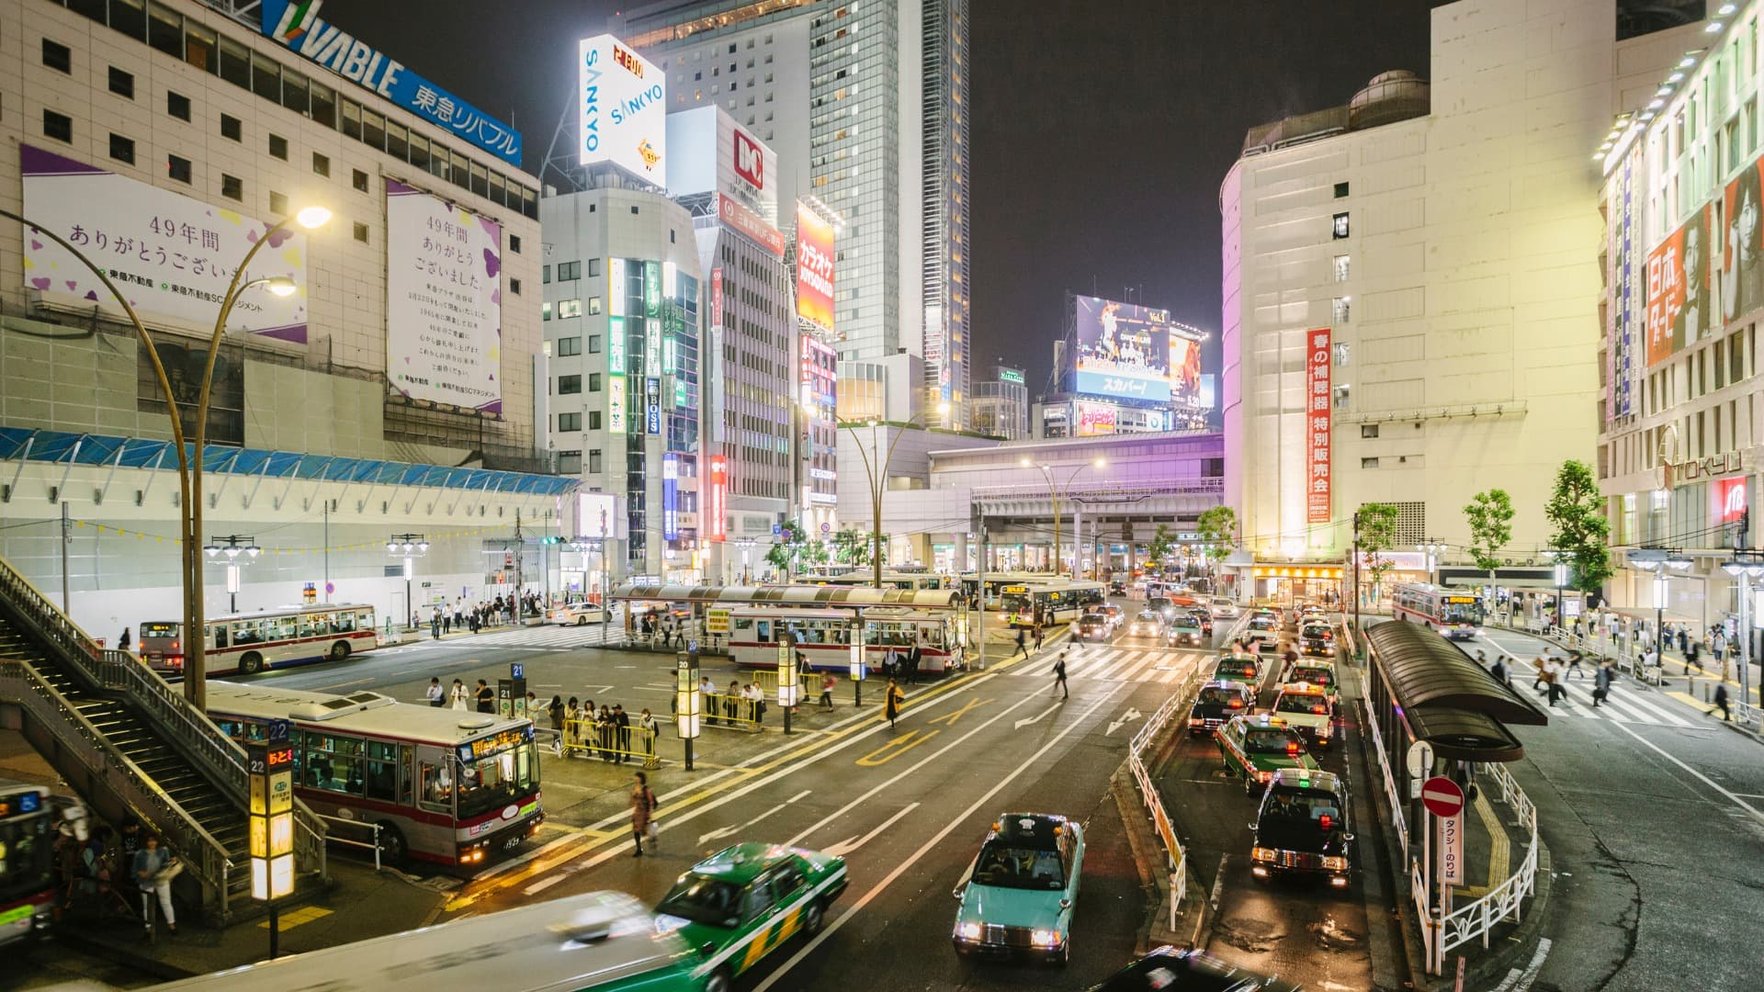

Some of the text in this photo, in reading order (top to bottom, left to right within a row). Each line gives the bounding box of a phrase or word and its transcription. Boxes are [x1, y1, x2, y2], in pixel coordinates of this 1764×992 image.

[586, 49, 603, 151] SANKYO
[611, 84, 662, 124] SANKYO
[412, 84, 518, 155] 東急リバブル
[150, 216, 219, 251] 49年間
[427, 216, 467, 243] 49年間
[423, 237, 473, 265] ありがとう
[800, 239, 832, 279] カラオケ
[110, 269, 153, 287] 東急不動産
[1649, 246, 1675, 301] 日本
[1313, 334, 1329, 410] 春の補聴器
[650, 396, 658, 432] BOSS
[1313, 416, 1328, 492] 特別販売会
[1671, 450, 1742, 484] TOKYU
[513, 665, 523, 677] 21
[679, 661, 688, 669] 20
[501, 689, 510, 698] 21
[270, 722, 287, 740] 22
[251, 760, 264, 773] 22
[1445, 820, 1455, 878] タクシーのりば
